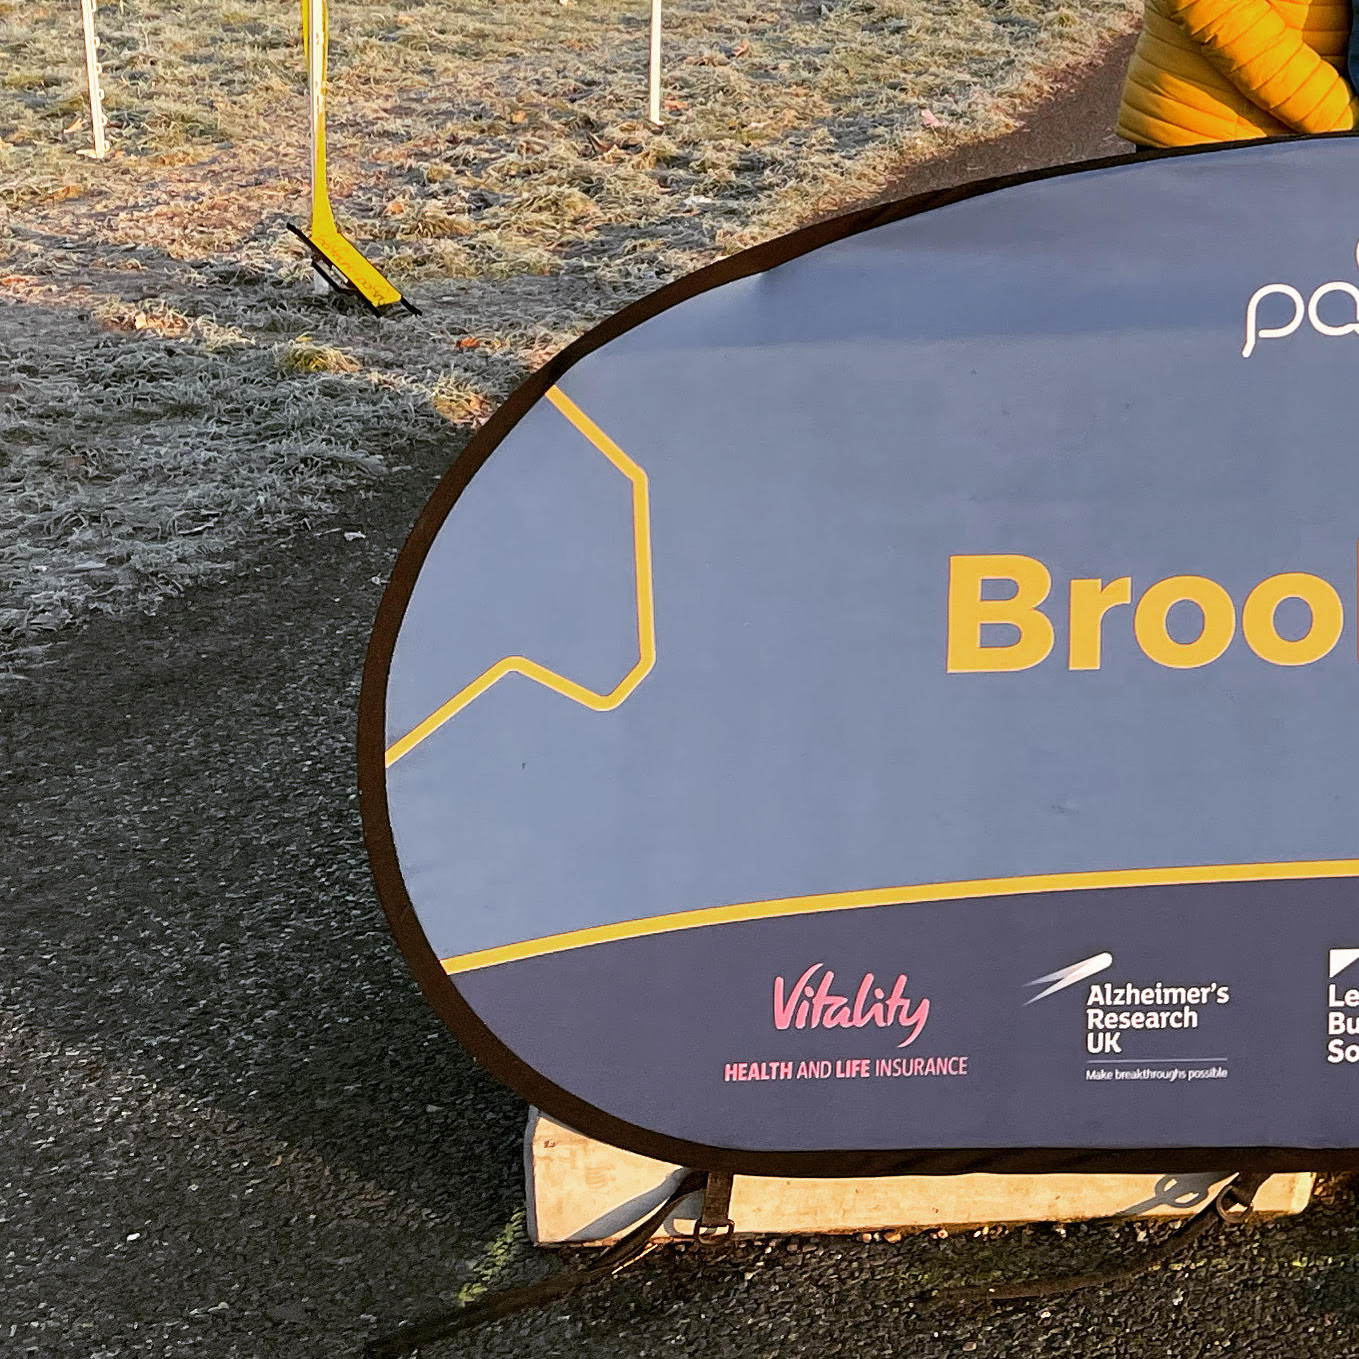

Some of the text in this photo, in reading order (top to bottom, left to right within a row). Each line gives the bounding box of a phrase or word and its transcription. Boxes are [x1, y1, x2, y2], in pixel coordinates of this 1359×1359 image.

[774, 963, 929, 1047] Vitality
[1087, 1006, 1197, 1029] Research
[1088, 1032, 1121, 1053] UK
[725, 1057, 967, 1081] HEALTH AND LIFE INSURANCE
[1086, 1067, 1227, 1081] Make breakthroughs possible
